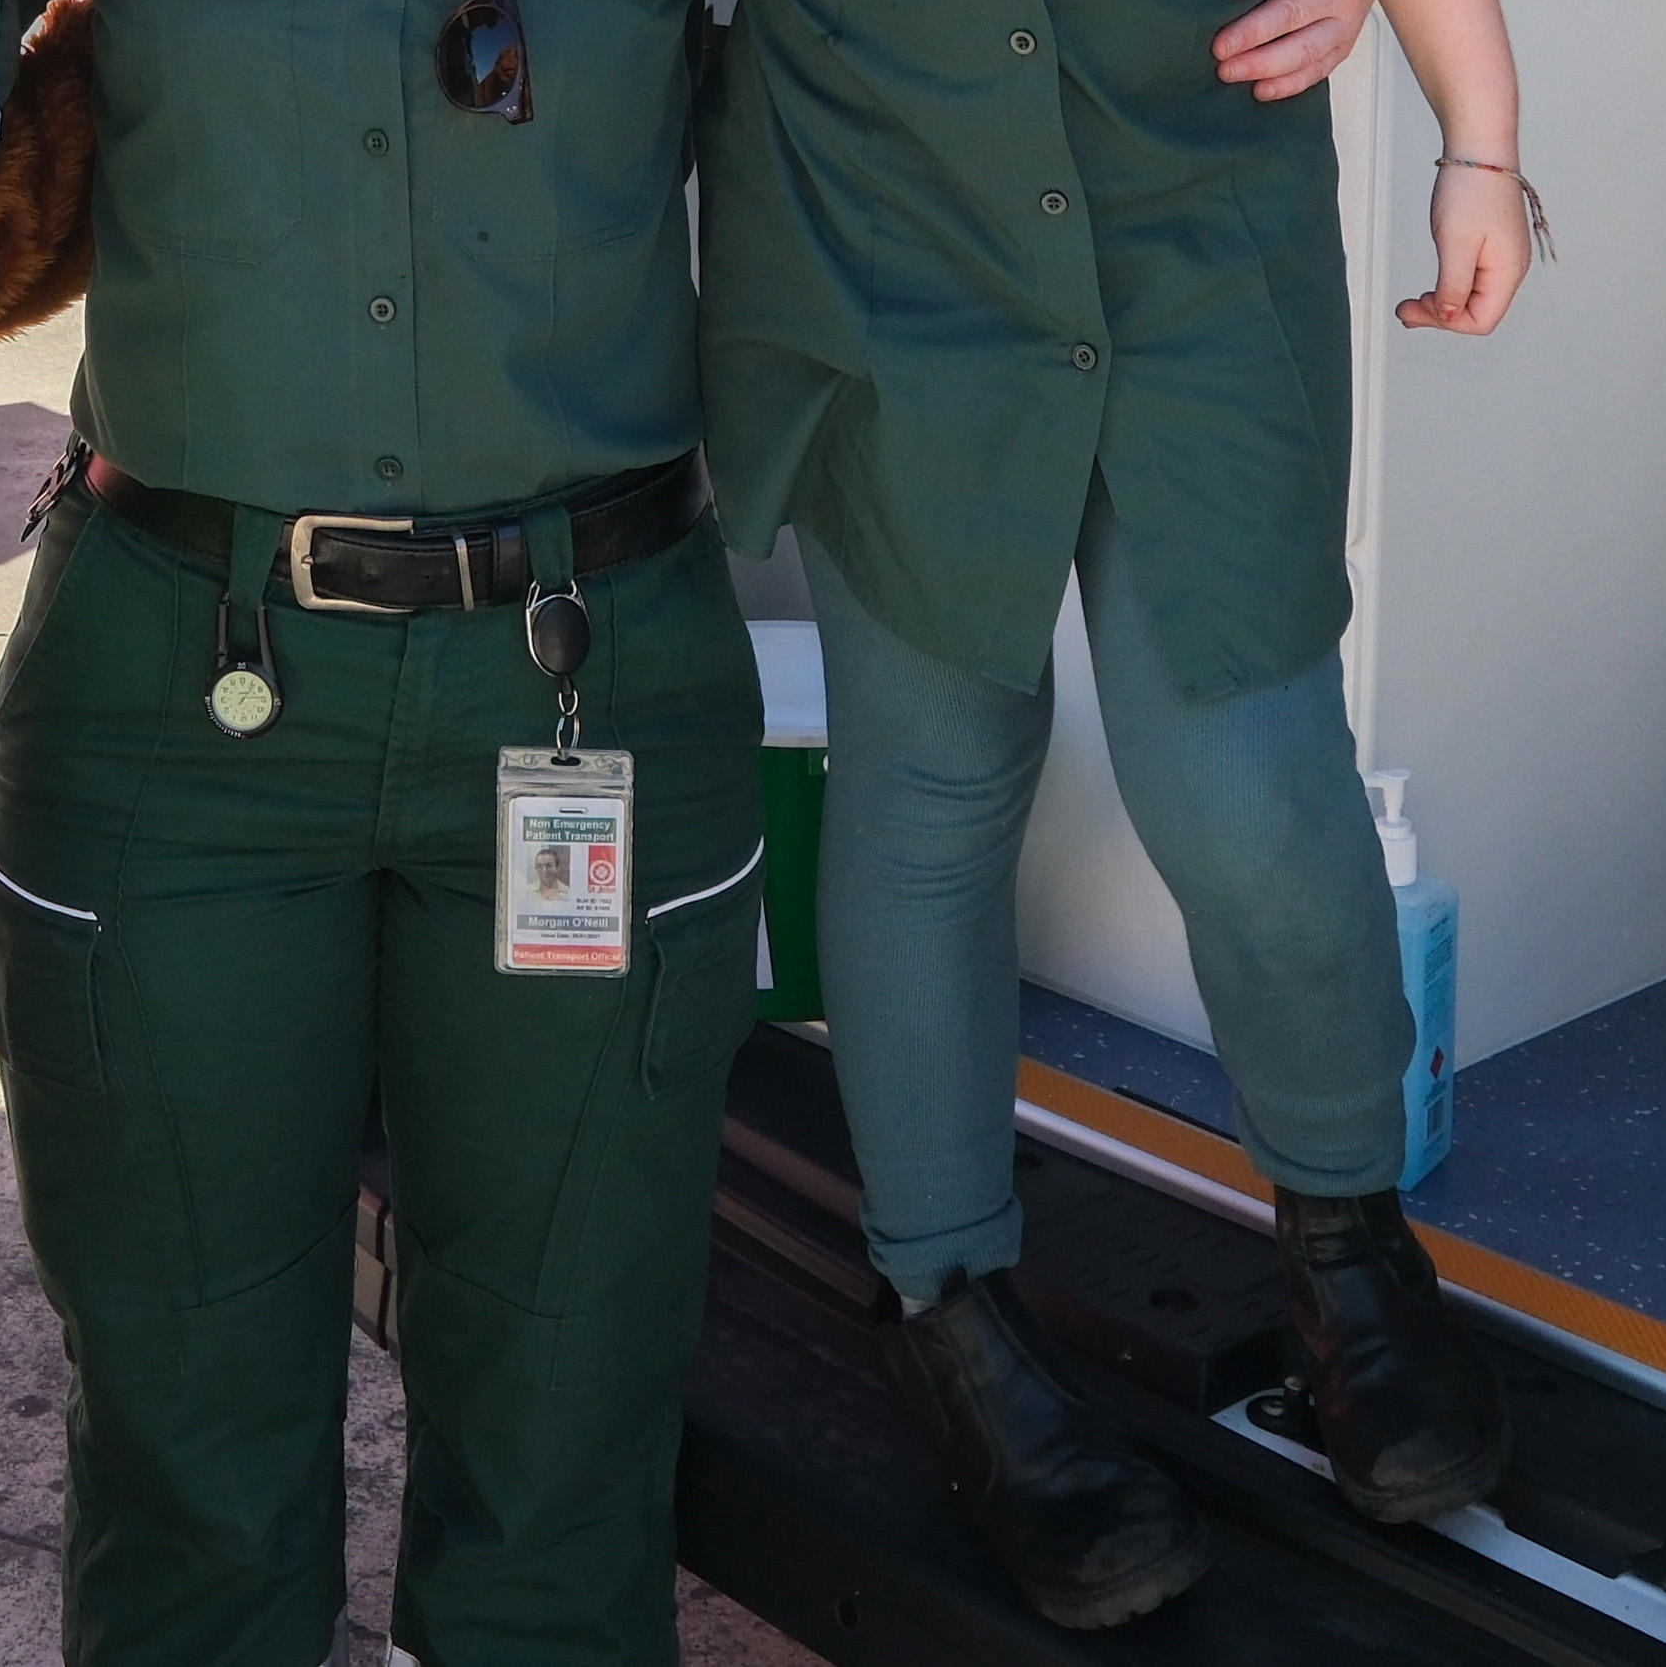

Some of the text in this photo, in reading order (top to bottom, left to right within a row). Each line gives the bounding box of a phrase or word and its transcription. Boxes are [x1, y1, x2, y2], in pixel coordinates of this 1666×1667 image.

[529, 819, 611, 831] Non Emergency
[526, 830, 614, 843] Patient Transport
[528, 917, 608, 928] Morgan O'Neill
[514, 950, 545, 959] Patient
[547, 951, 589, 961] Transport
